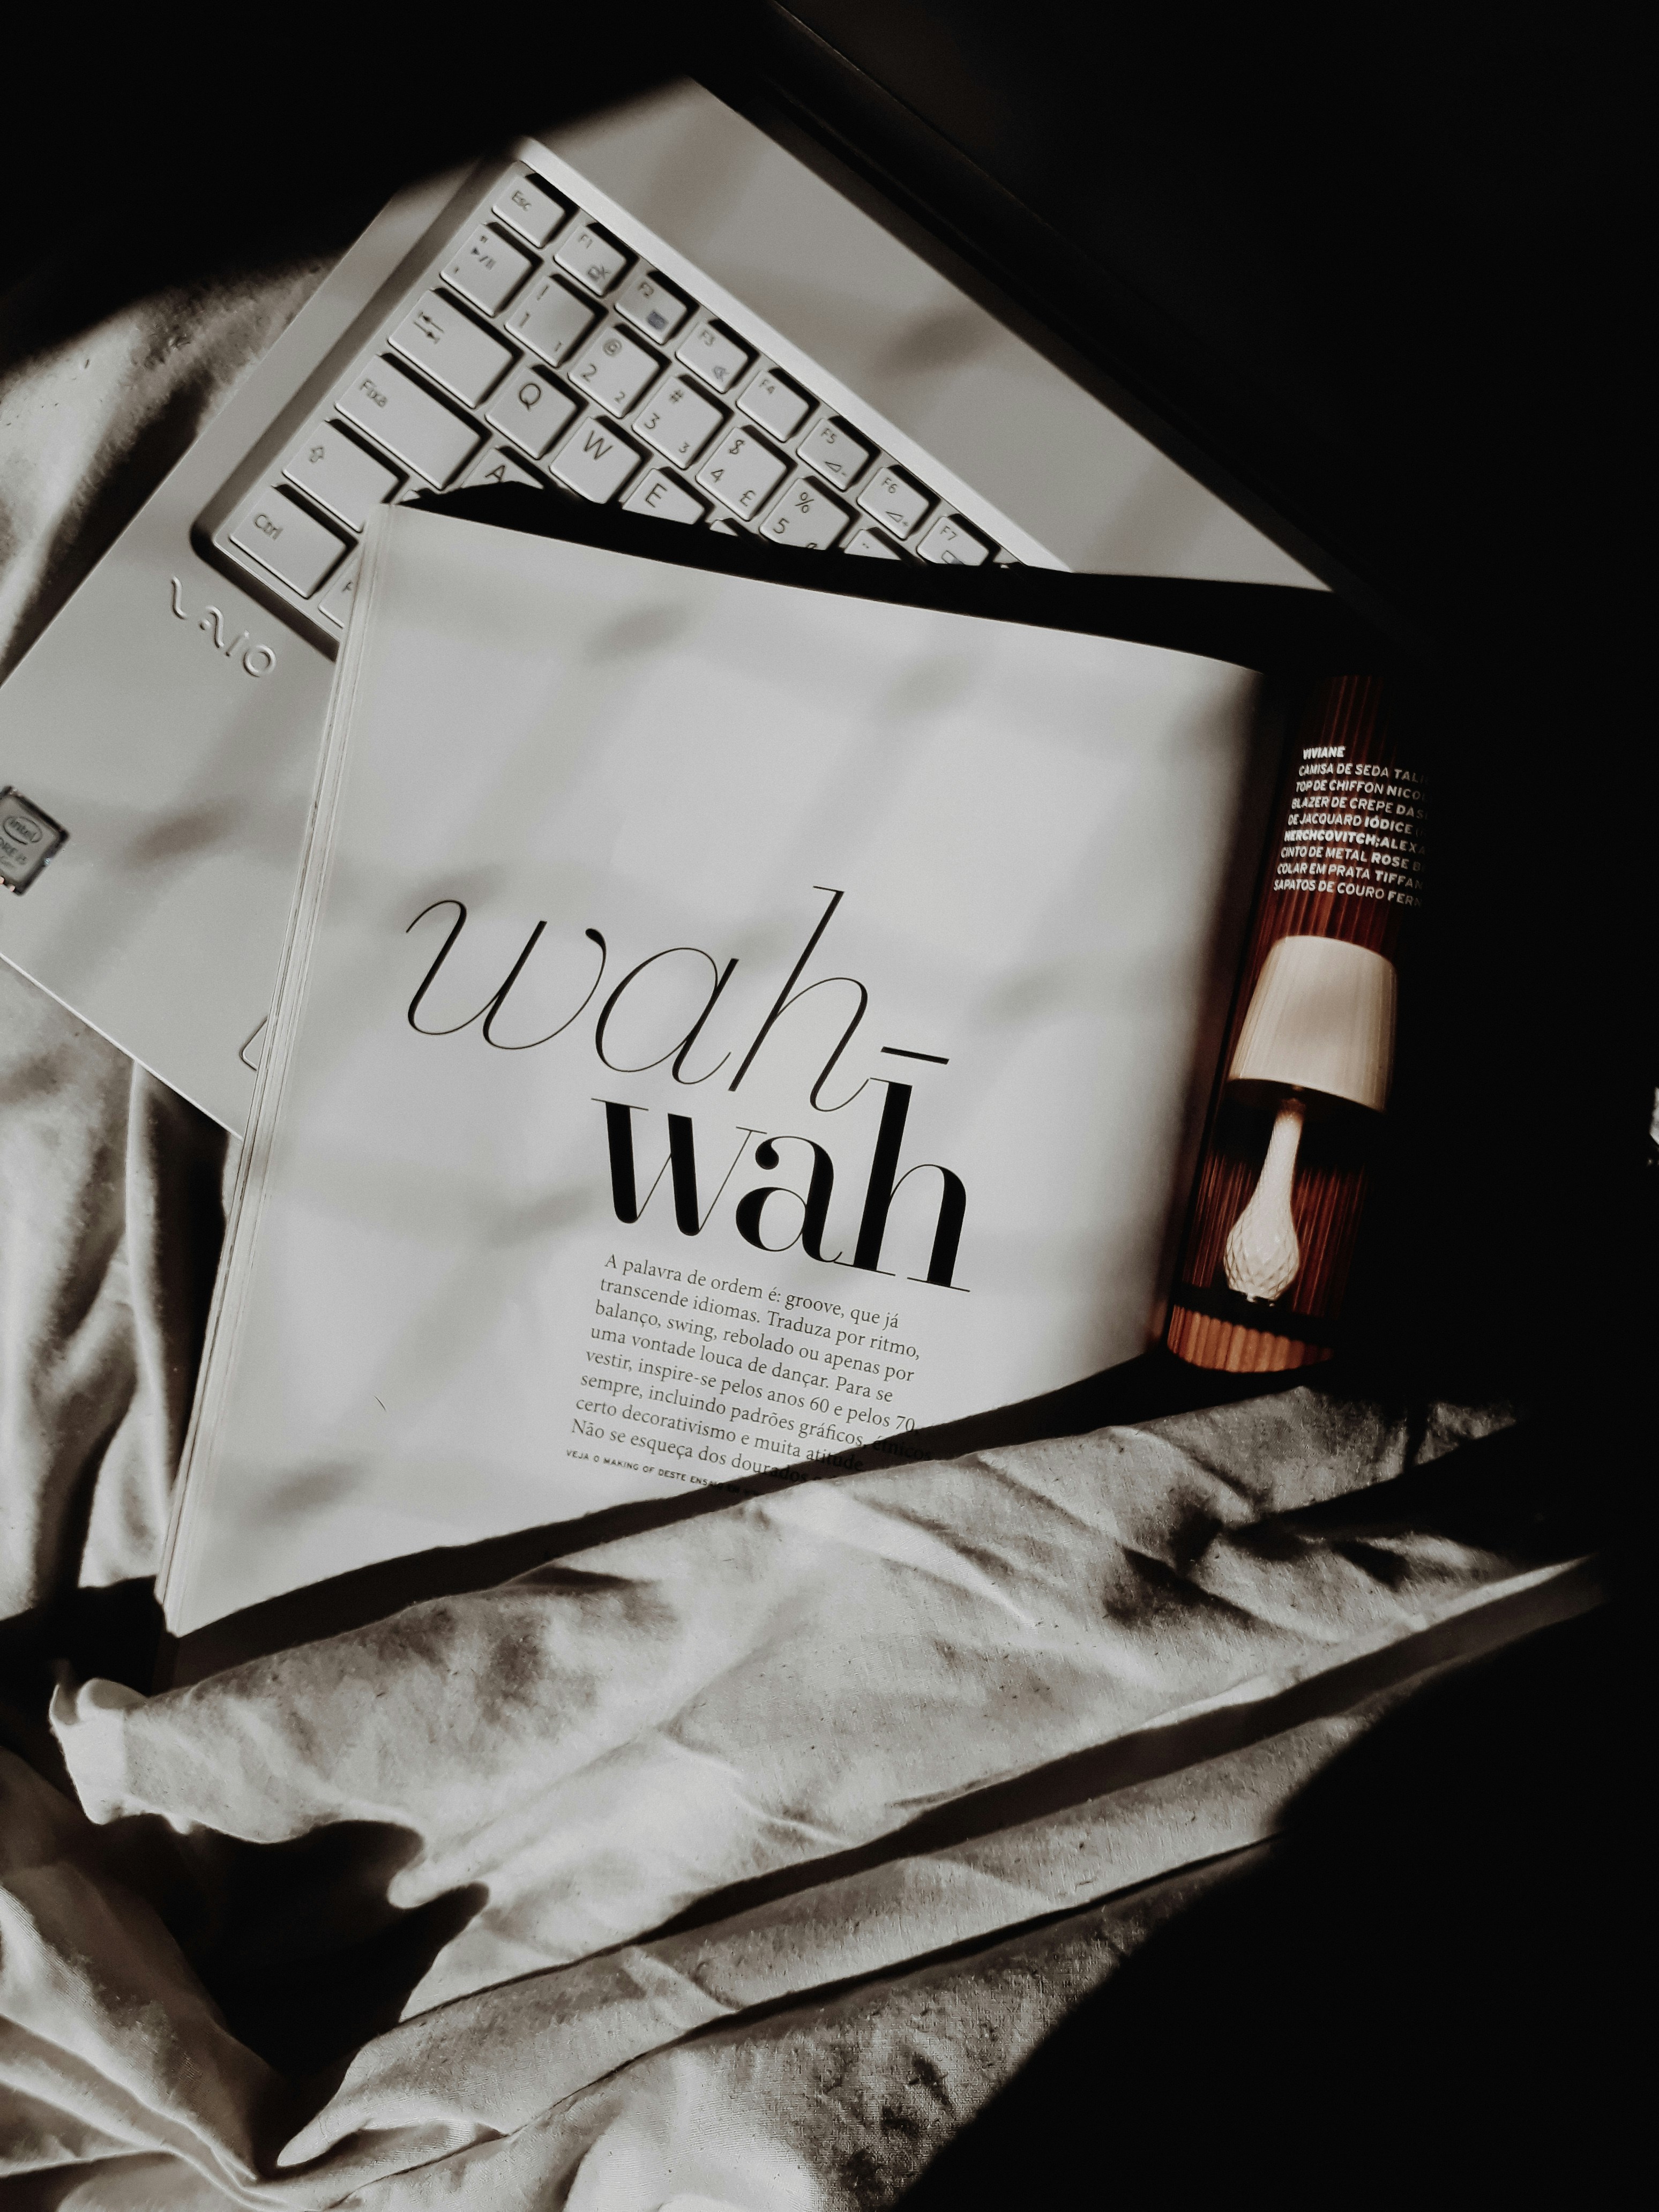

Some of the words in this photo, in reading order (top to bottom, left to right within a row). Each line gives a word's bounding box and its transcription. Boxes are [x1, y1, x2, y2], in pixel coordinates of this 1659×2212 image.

[518, 383, 542, 411] Q
[645, 413, 661, 430] 3
[583, 430, 614, 461] W
[484, 464, 506, 483] A
[710, 468, 725, 483] 4
[881, 476, 899, 494] F6
[644, 482, 668, 508] E
[773, 517, 790, 535] 5
[940, 525, 958, 541] F7
[1298, 763, 1334, 776] CAMISA
[1336, 763, 1354, 775] DE
[1355, 763, 1389, 778] SEDA
[1296, 780, 1313, 793] TOP
[1313, 779, 1328, 791] DE
[1329, 779, 1384, 795] CHIFFON
[1331, 796, 1348, 809] DE
[1349, 797, 1394, 814] CREPE
[1288, 813, 1299, 826] DE
[1299, 812, 1362, 826] JACQUARD
[1364, 814, 1414, 835] IÓDICE
[1308, 846, 1324, 858] DE
[1325, 847, 1368, 863] METAL
[1371, 851, 1409, 870] ROSE
[1277, 862, 1308, 875] COLAR
[1309, 862, 1327, 875] EM
[1327, 864, 1370, 880] PRATA
[1273, 879, 1316, 891] SAPATOS
[1318, 880, 1335, 893] DE
[1337, 882, 1385, 900] COURO
[591, 1077, 970, 1292] wah
[604, 1254, 618, 1269] A
[623, 1259, 682, 1282] palavra
[687, 1269, 706, 1287] de
[711, 1277, 763, 1299] ordem
[768, 1288, 781, 1303] é:
[784, 1295, 845, 1319] groove,
[850, 1309, 880, 1325] que
[882, 1312, 899, 1331] já
[601, 1278, 689, 1307] transcende
[692, 1296, 760, 1323] idiomas.
[767, 1310, 831, 1339] Traduza
[835, 1331, 866, 1346] por
[869, 1335, 920, 1361] ritmo,
[595, 1298, 661, 1329] balanço,
[667, 1318, 717, 1342] swing,
[723, 1328, 794, 1355] rebolado
[798, 1347, 819, 1361] ou
[824, 1353, 880, 1374] apenas
[883, 1366, 915, 1382] por
[591, 1328, 625, 1344] uma
[632, 1335, 696, 1358] vontade
[699, 1345, 742, 1369] louca
[748, 1356, 767, 1374] de
[771, 1362, 829, 1388] dançar.
[834, 1376, 871, 1398] Para
[876, 1389, 893, 1402] se
[586, 1351, 632, 1372] vestir,
[638, 1362, 716, 1388] inspire-se
[720, 1379, 763, 1400] pelos
[767, 1391, 805, 1408] anos
[810, 1396, 829, 1413] 60
[834, 1406, 843, 1416] e
[846, 1407, 891, 1427] pelos
[581, 1375, 642, 1399] sempre,
[648, 1389, 726, 1415] incluindo
[728, 1407, 795, 1431] padrões
[798, 1421, 868, 1449] gráficos,
[576, 1399, 617, 1416] certo
[622, 1404, 736, 1442] decorativismo
[741, 1434, 750, 1445] e
[754, 1437, 801, 1458] muita
[571, 1418, 604, 1439] Não
[610, 1430, 626, 1443] se
[630, 1432, 693, 1460] esqueça
[698, 1445, 727, 1465] dos
[566, 1448, 589, 1460] VEJA
[593, 1454, 600, 1463] O
[603, 1458, 639, 1471] MAKING
[642, 1466, 655, 1474] OF
